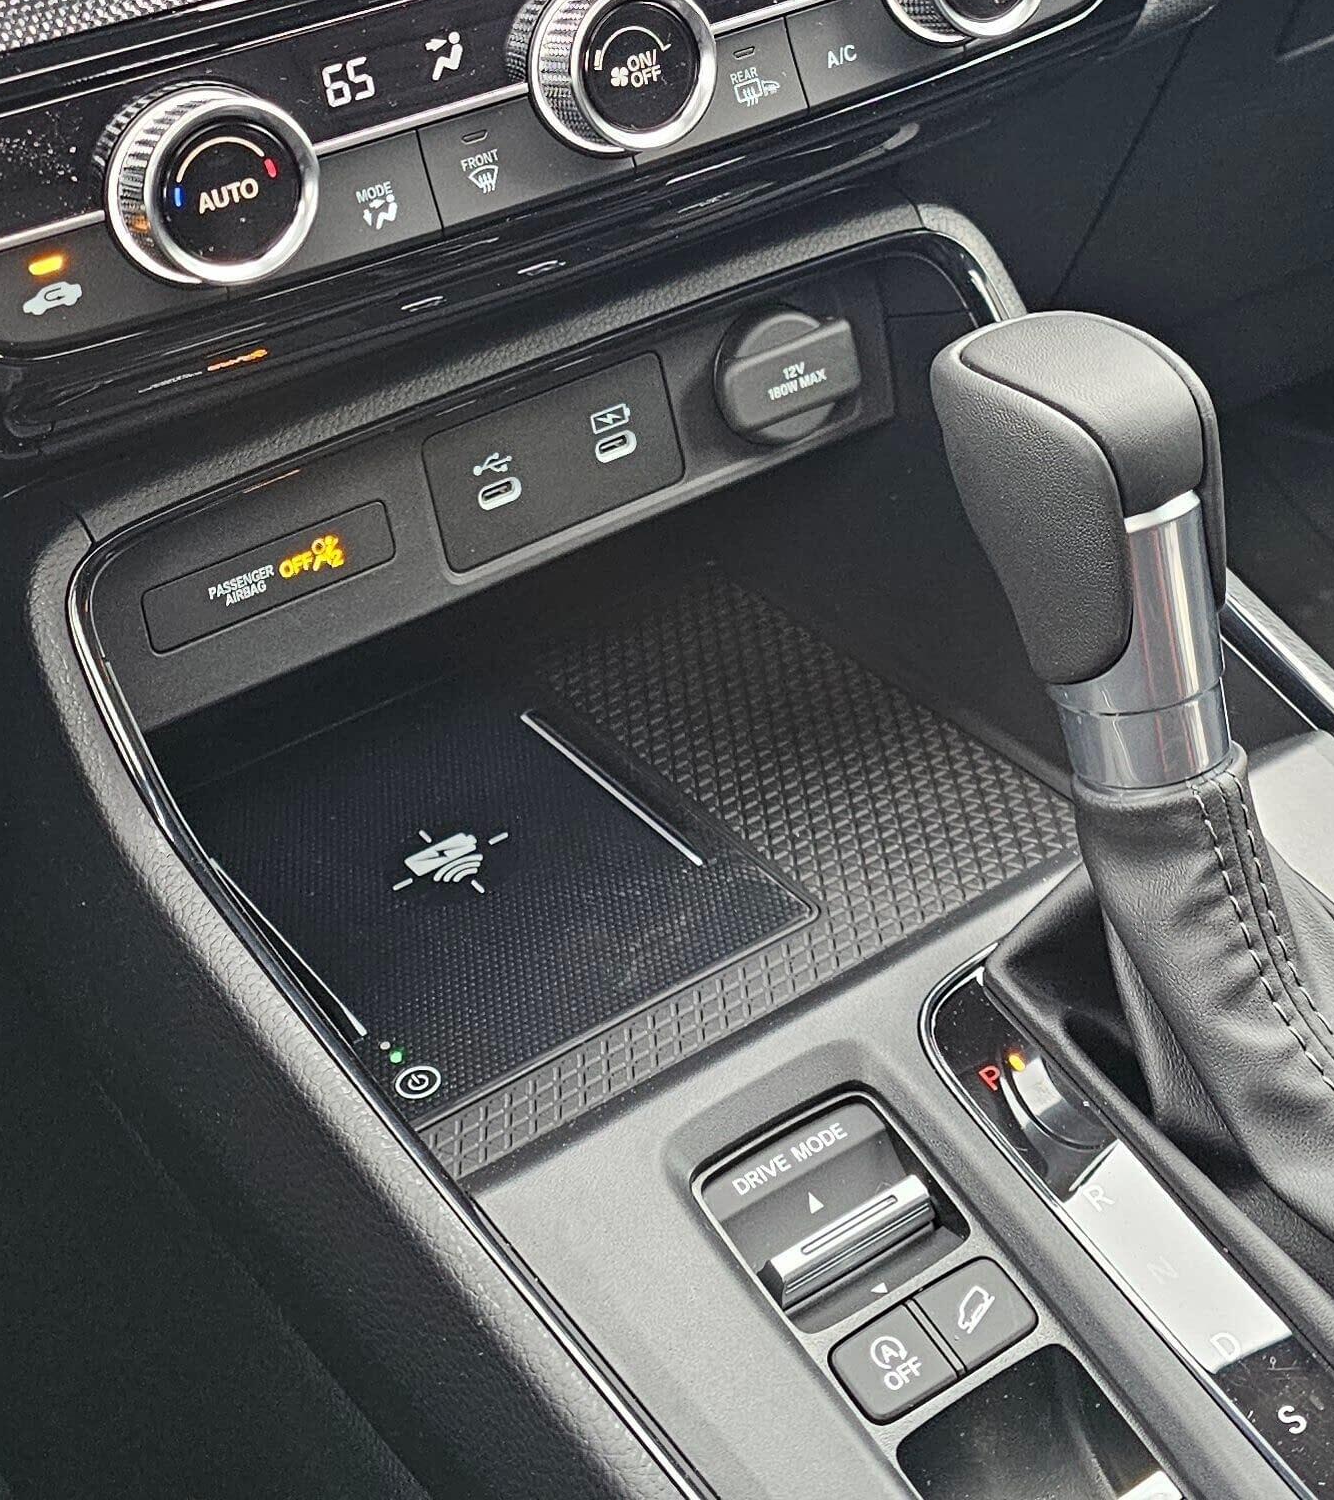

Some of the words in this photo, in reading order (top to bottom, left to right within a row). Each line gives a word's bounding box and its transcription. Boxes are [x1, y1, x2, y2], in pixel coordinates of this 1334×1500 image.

[627, 49, 657, 71] ON/
[827, 44, 857, 69] A/C
[321, 56, 376, 108] 65
[630, 65, 662, 88] OFF
[729, 66, 759, 85] REAR
[461, 148, 499, 170] FRONT
[198, 177, 260, 214] AUTO
[355, 181, 393, 202] MODE
[767, 380, 799, 401] 180W
[799, 368, 827, 389] MAX
[782, 361, 805, 380] 12V
[207, 563, 275, 600] PASSENGER
[278, 550, 313, 579] OFF
[225, 579, 267, 607] AIRBAG
[978, 1064, 1003, 1091] P
[731, 1152, 793, 1197] DRIVE
[790, 1121, 849, 1165] MODE
[1081, 1183, 1116, 1212] R
[1208, 1331, 1243, 1361] D
[883, 1357, 924, 1392] OFF
[1277, 1404, 1308, 1435] S
